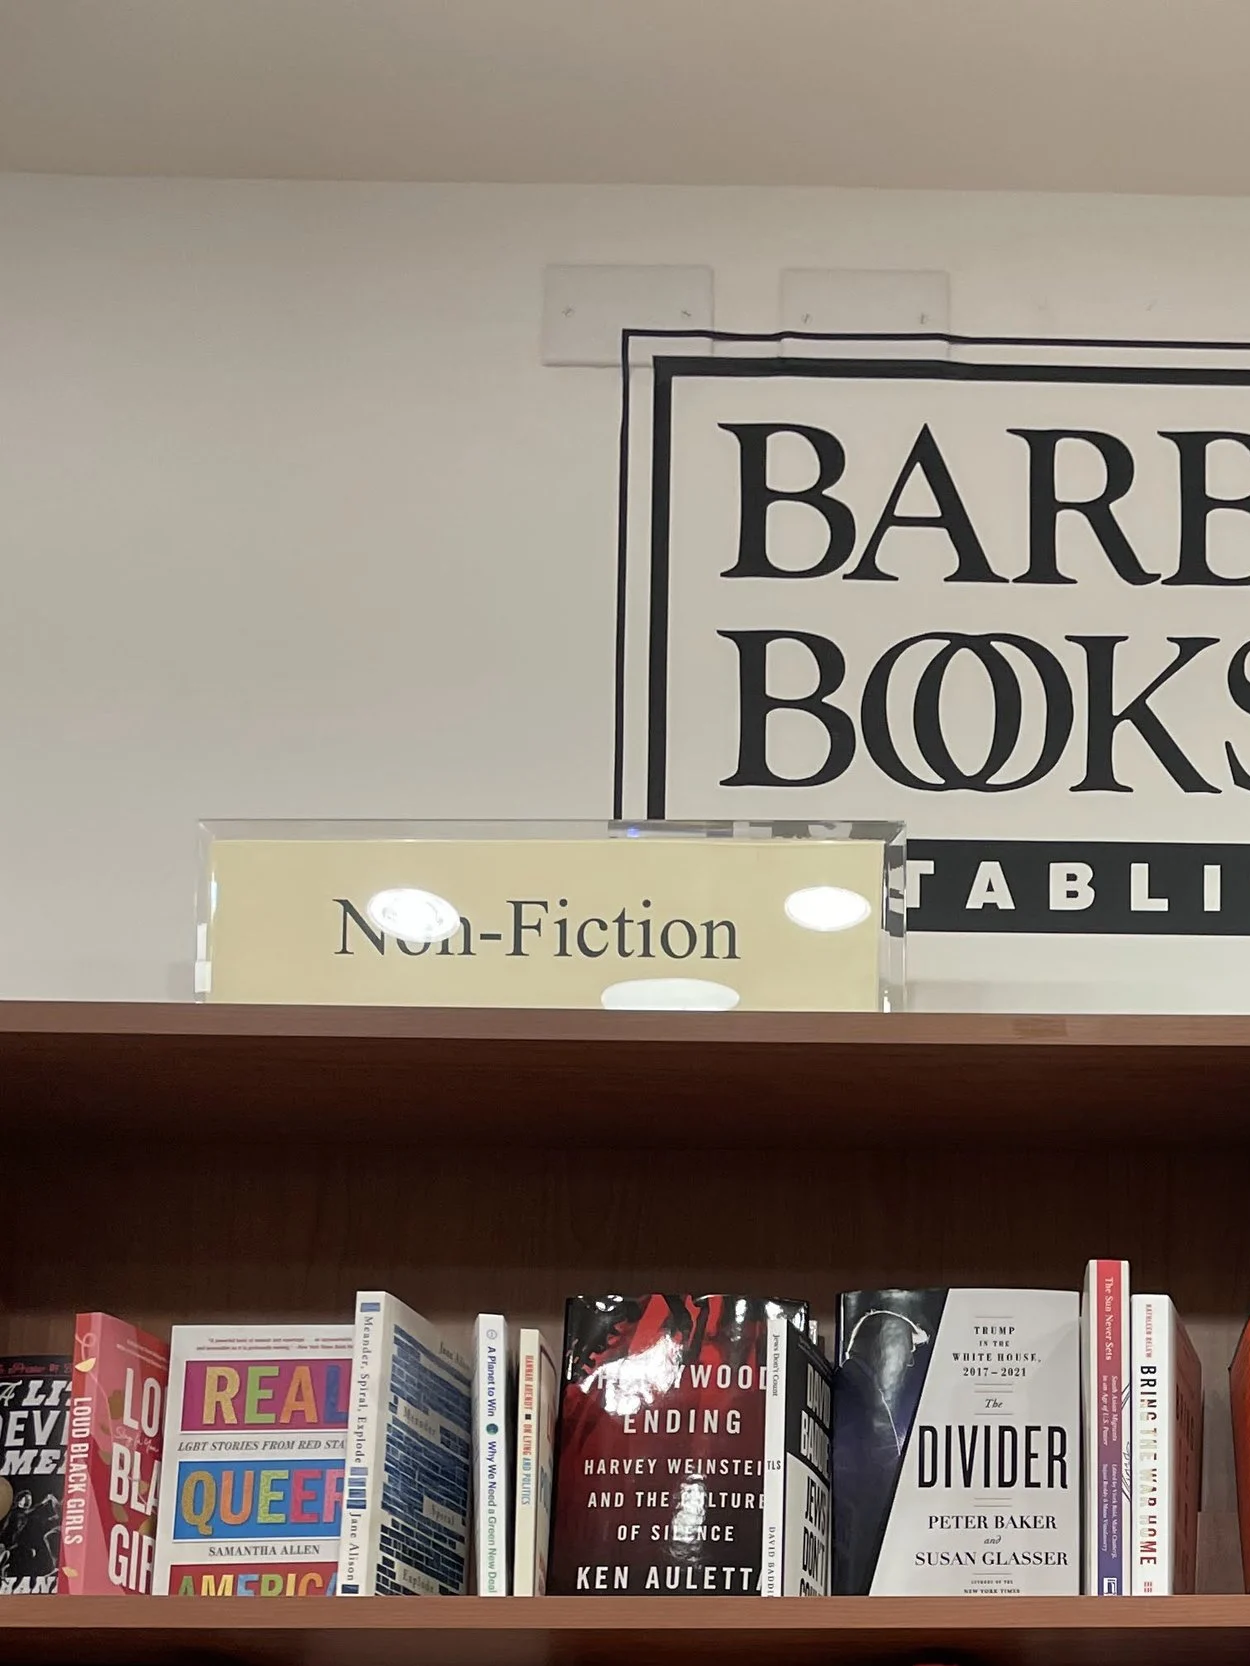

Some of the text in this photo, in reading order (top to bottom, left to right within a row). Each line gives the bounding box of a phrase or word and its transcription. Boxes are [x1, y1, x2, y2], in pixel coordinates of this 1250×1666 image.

[974, 1326, 1016, 1335] TRUMP
[952, 1352, 1042, 1363] WHITE HOUSE,
[623, 1409, 742, 1434] ENDING
[178, 1439, 322, 1453] LGBT STORIES FROM RED
[918, 1425, 1069, 1490] DIVIDER
[64, 1397, 92, 1545] LOUD BLACK GIRLS
[928, 1515, 1058, 1530] PETER BAKER
[209, 1545, 320, 1558] SAMANTHA ALLEN
[347, 1512, 362, 1582] Jane Alison
[915, 1551, 1069, 1566] SUSAN GLASSER
